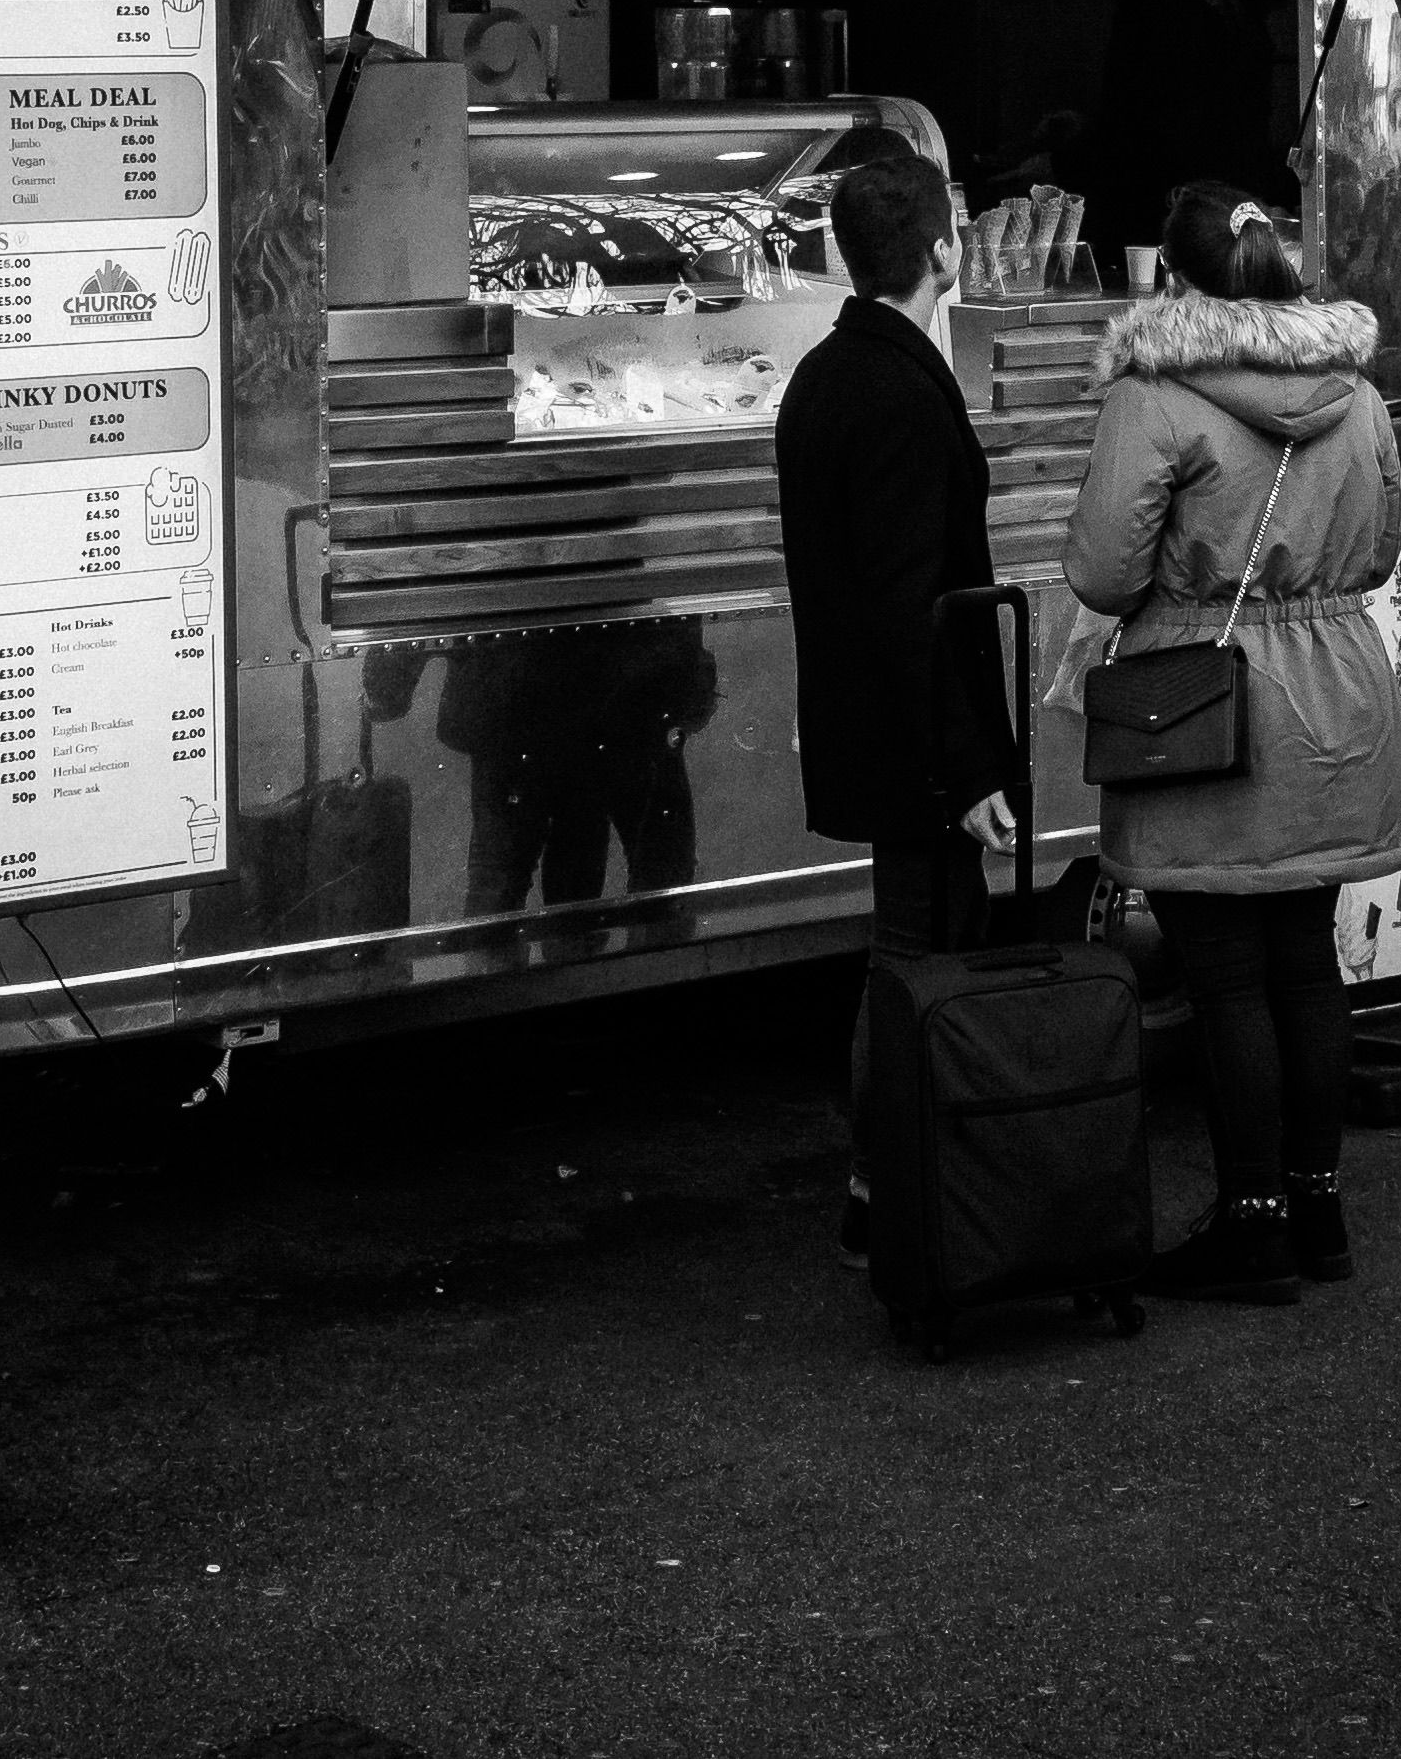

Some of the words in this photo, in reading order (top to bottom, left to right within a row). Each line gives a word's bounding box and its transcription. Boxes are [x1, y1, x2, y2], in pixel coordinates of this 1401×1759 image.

[116, 6, 149, 16] £2.50
[117, 32, 150, 43] £3.50
[9, 88, 82, 109] MEAL
[90, 87, 156, 107] DEAL
[11, 118, 33, 129] Hot
[37, 117, 67, 131] Dog,
[70, 116, 106, 130] Chips
[110, 118, 119, 127] &
[122, 116, 159, 128] Drink
[9, 137, 41, 150] Jumbo
[121, 134, 155, 146] £6.00
[11, 156, 45, 167] Vegan
[122, 152, 156, 164] £6.00
[12, 175, 56, 187] Gourmet
[124, 171, 156, 183] £7.00
[12, 193, 39, 204] Chilli
[124, 189, 156, 200] £7.00
[63, 293, 157, 313] CHURROS
[64, 378, 167, 403] DONUTS
[6, 421, 35, 434] Sugar
[38, 417, 73, 430] Dusted
[89, 413, 124, 426] £3.00
[89, 431, 125, 444] £4.00
[86, 491, 120, 503] £3.50
[86, 508, 120, 521] £4.50
[86, 529, 120, 541] £5.00
[81, 546, 120, 558] +£1.00
[79, 561, 121, 573] +£2.00
[50, 620, 71, 633] Hot
[75, 617, 113, 630] Drinks
[170, 627, 204, 640] £3.00
[0, 645, 34, 660] £3.00
[175, 647, 205, 660] +50p
[0, 666, 34, 680] £3.00
[0, 687, 35, 701] £3.00
[0, 708, 35, 722] £3.00
[52, 704, 72, 715] Tea
[171, 708, 205, 721] £2.00
[90, 717, 134, 733] Breakfast
[0, 729, 36, 742] £3.00
[172, 728, 206, 741] £2.00
[0, 749, 36, 763] £3.00
[53, 744, 73, 757] Earl
[75, 742, 99, 757] Grey
[172, 748, 206, 762] £2.00
[53, 764, 86, 778] Herbal
[89, 759, 130, 773] selection
[0, 770, 36, 784] £3.00
[12, 791, 37, 804] 50p
[53, 786, 81, 799] Please
[85, 783, 100, 794] ask
[0, 851, 36, 866] £3.00
